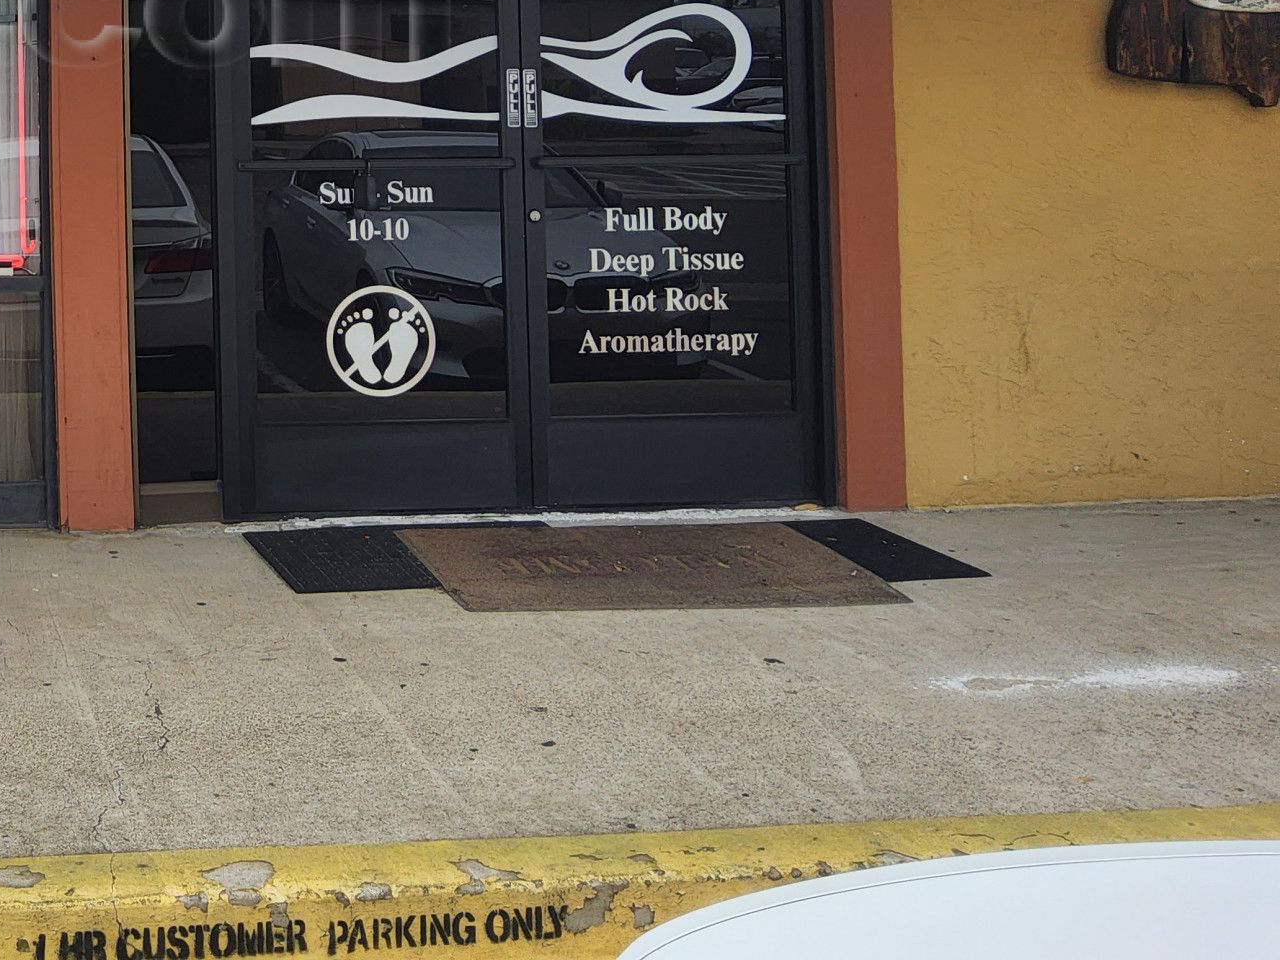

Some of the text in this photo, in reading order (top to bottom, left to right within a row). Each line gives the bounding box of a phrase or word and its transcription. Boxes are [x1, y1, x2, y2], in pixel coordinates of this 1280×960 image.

[509, 73, 519, 113] PULL
[525, 74, 536, 113] PULL
[320, 180, 434, 205] Su Sun
[346, 218, 410, 241] 10-10
[604, 206, 728, 235] Full Body
[589, 246, 745, 277] Deep Tissue
[606, 286, 730, 313] Hot Rock
[578, 328, 759, 356] Aromatherapy
[60, 930, 107, 960] HR
[116, 919, 308, 960] CUSTOMER
[327, 911, 477, 956] PARKING
[484, 904, 569, 944] ONLY
